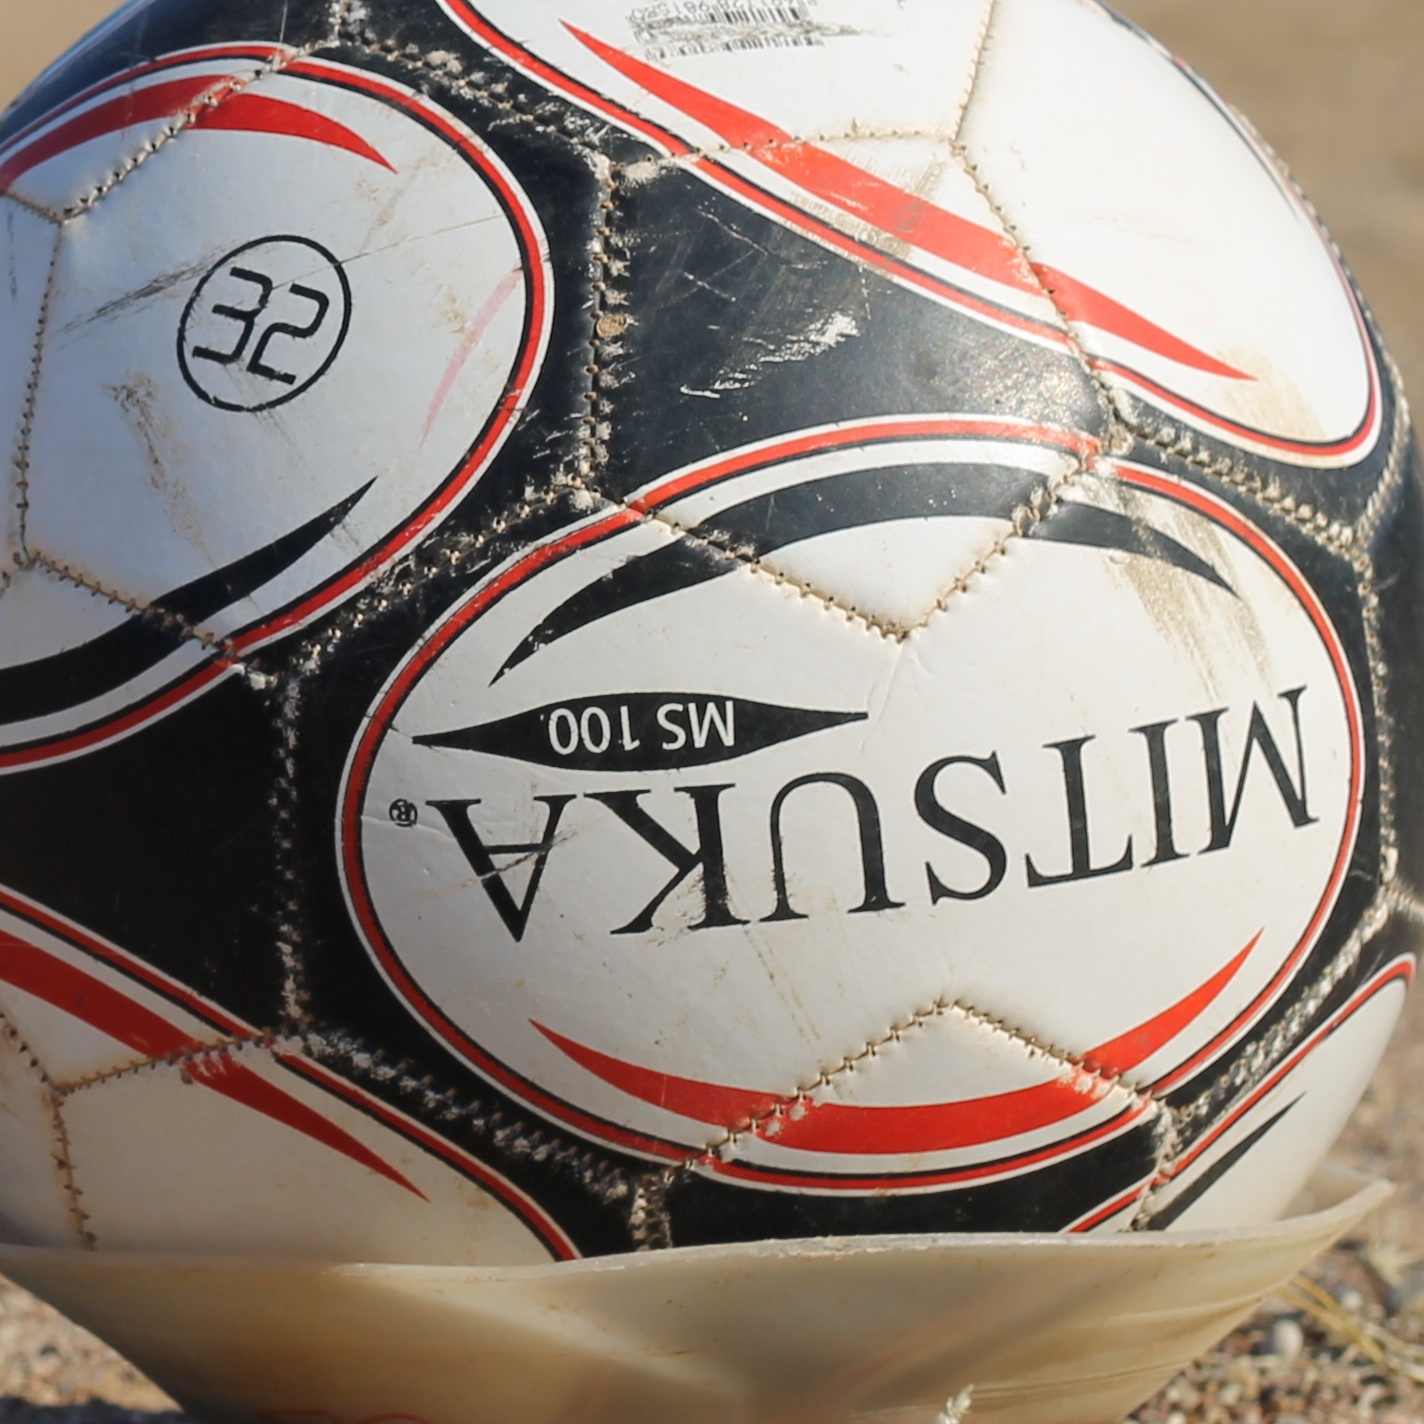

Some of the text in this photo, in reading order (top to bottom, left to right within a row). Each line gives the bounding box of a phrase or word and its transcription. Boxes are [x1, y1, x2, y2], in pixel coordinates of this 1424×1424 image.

[192, 266, 329, 385] 32
[549, 699, 735, 757] MS 100
[425, 684, 1320, 943] MITSUKA
